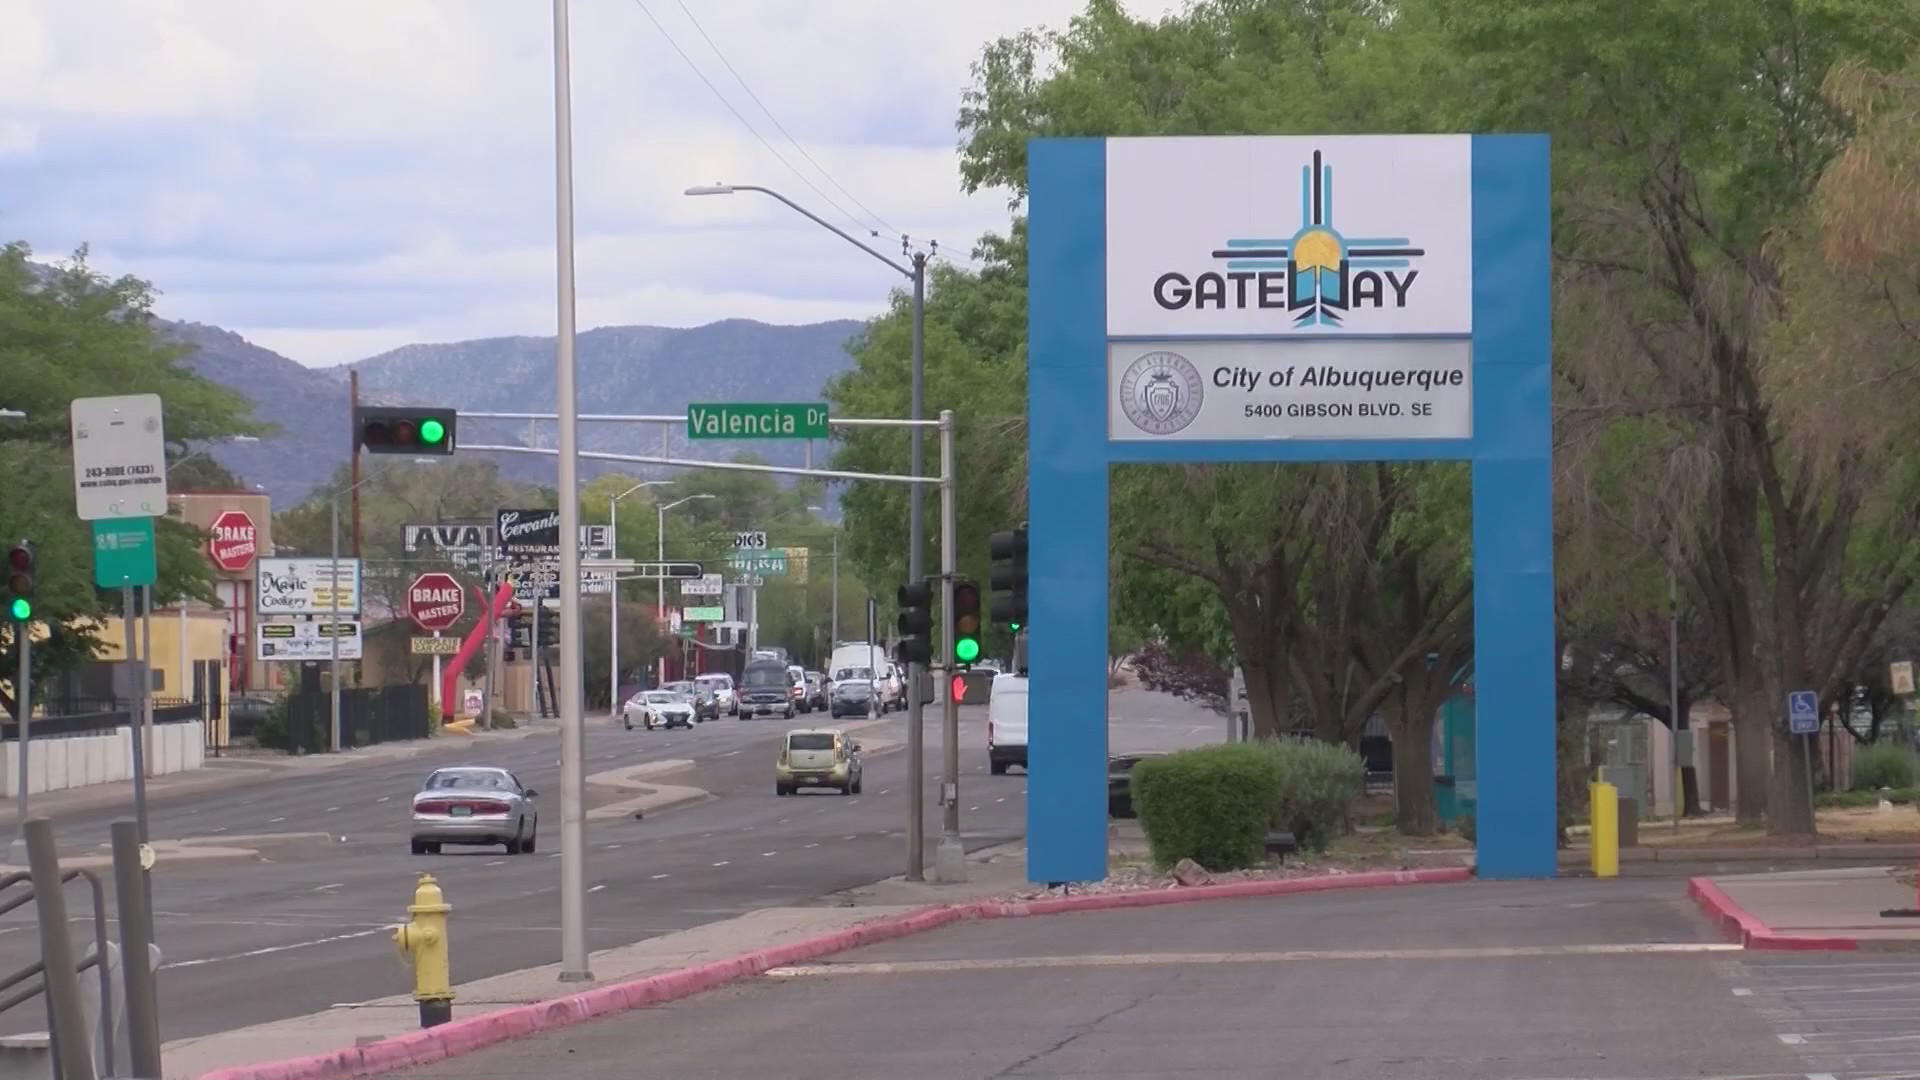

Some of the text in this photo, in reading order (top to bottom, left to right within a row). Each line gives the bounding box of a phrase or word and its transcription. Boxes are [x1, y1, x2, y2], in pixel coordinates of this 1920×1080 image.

[1153, 260, 1418, 311] GATEWAY
[1213, 366, 1464, 392] City of Albuquerque
[1244, 403, 1433, 417] 5400 GIBSON BLVD. SE
[690, 408, 826, 434] Valencia Dr
[215, 526, 254, 542] BRAKE
[500, 511, 560, 541] Cervante
[220, 541, 255, 560] MASTERS
[507, 544, 560, 553] RESTAURAN
[412, 588, 460, 603] BRAKE
[417, 603, 460, 621] MASTERS
